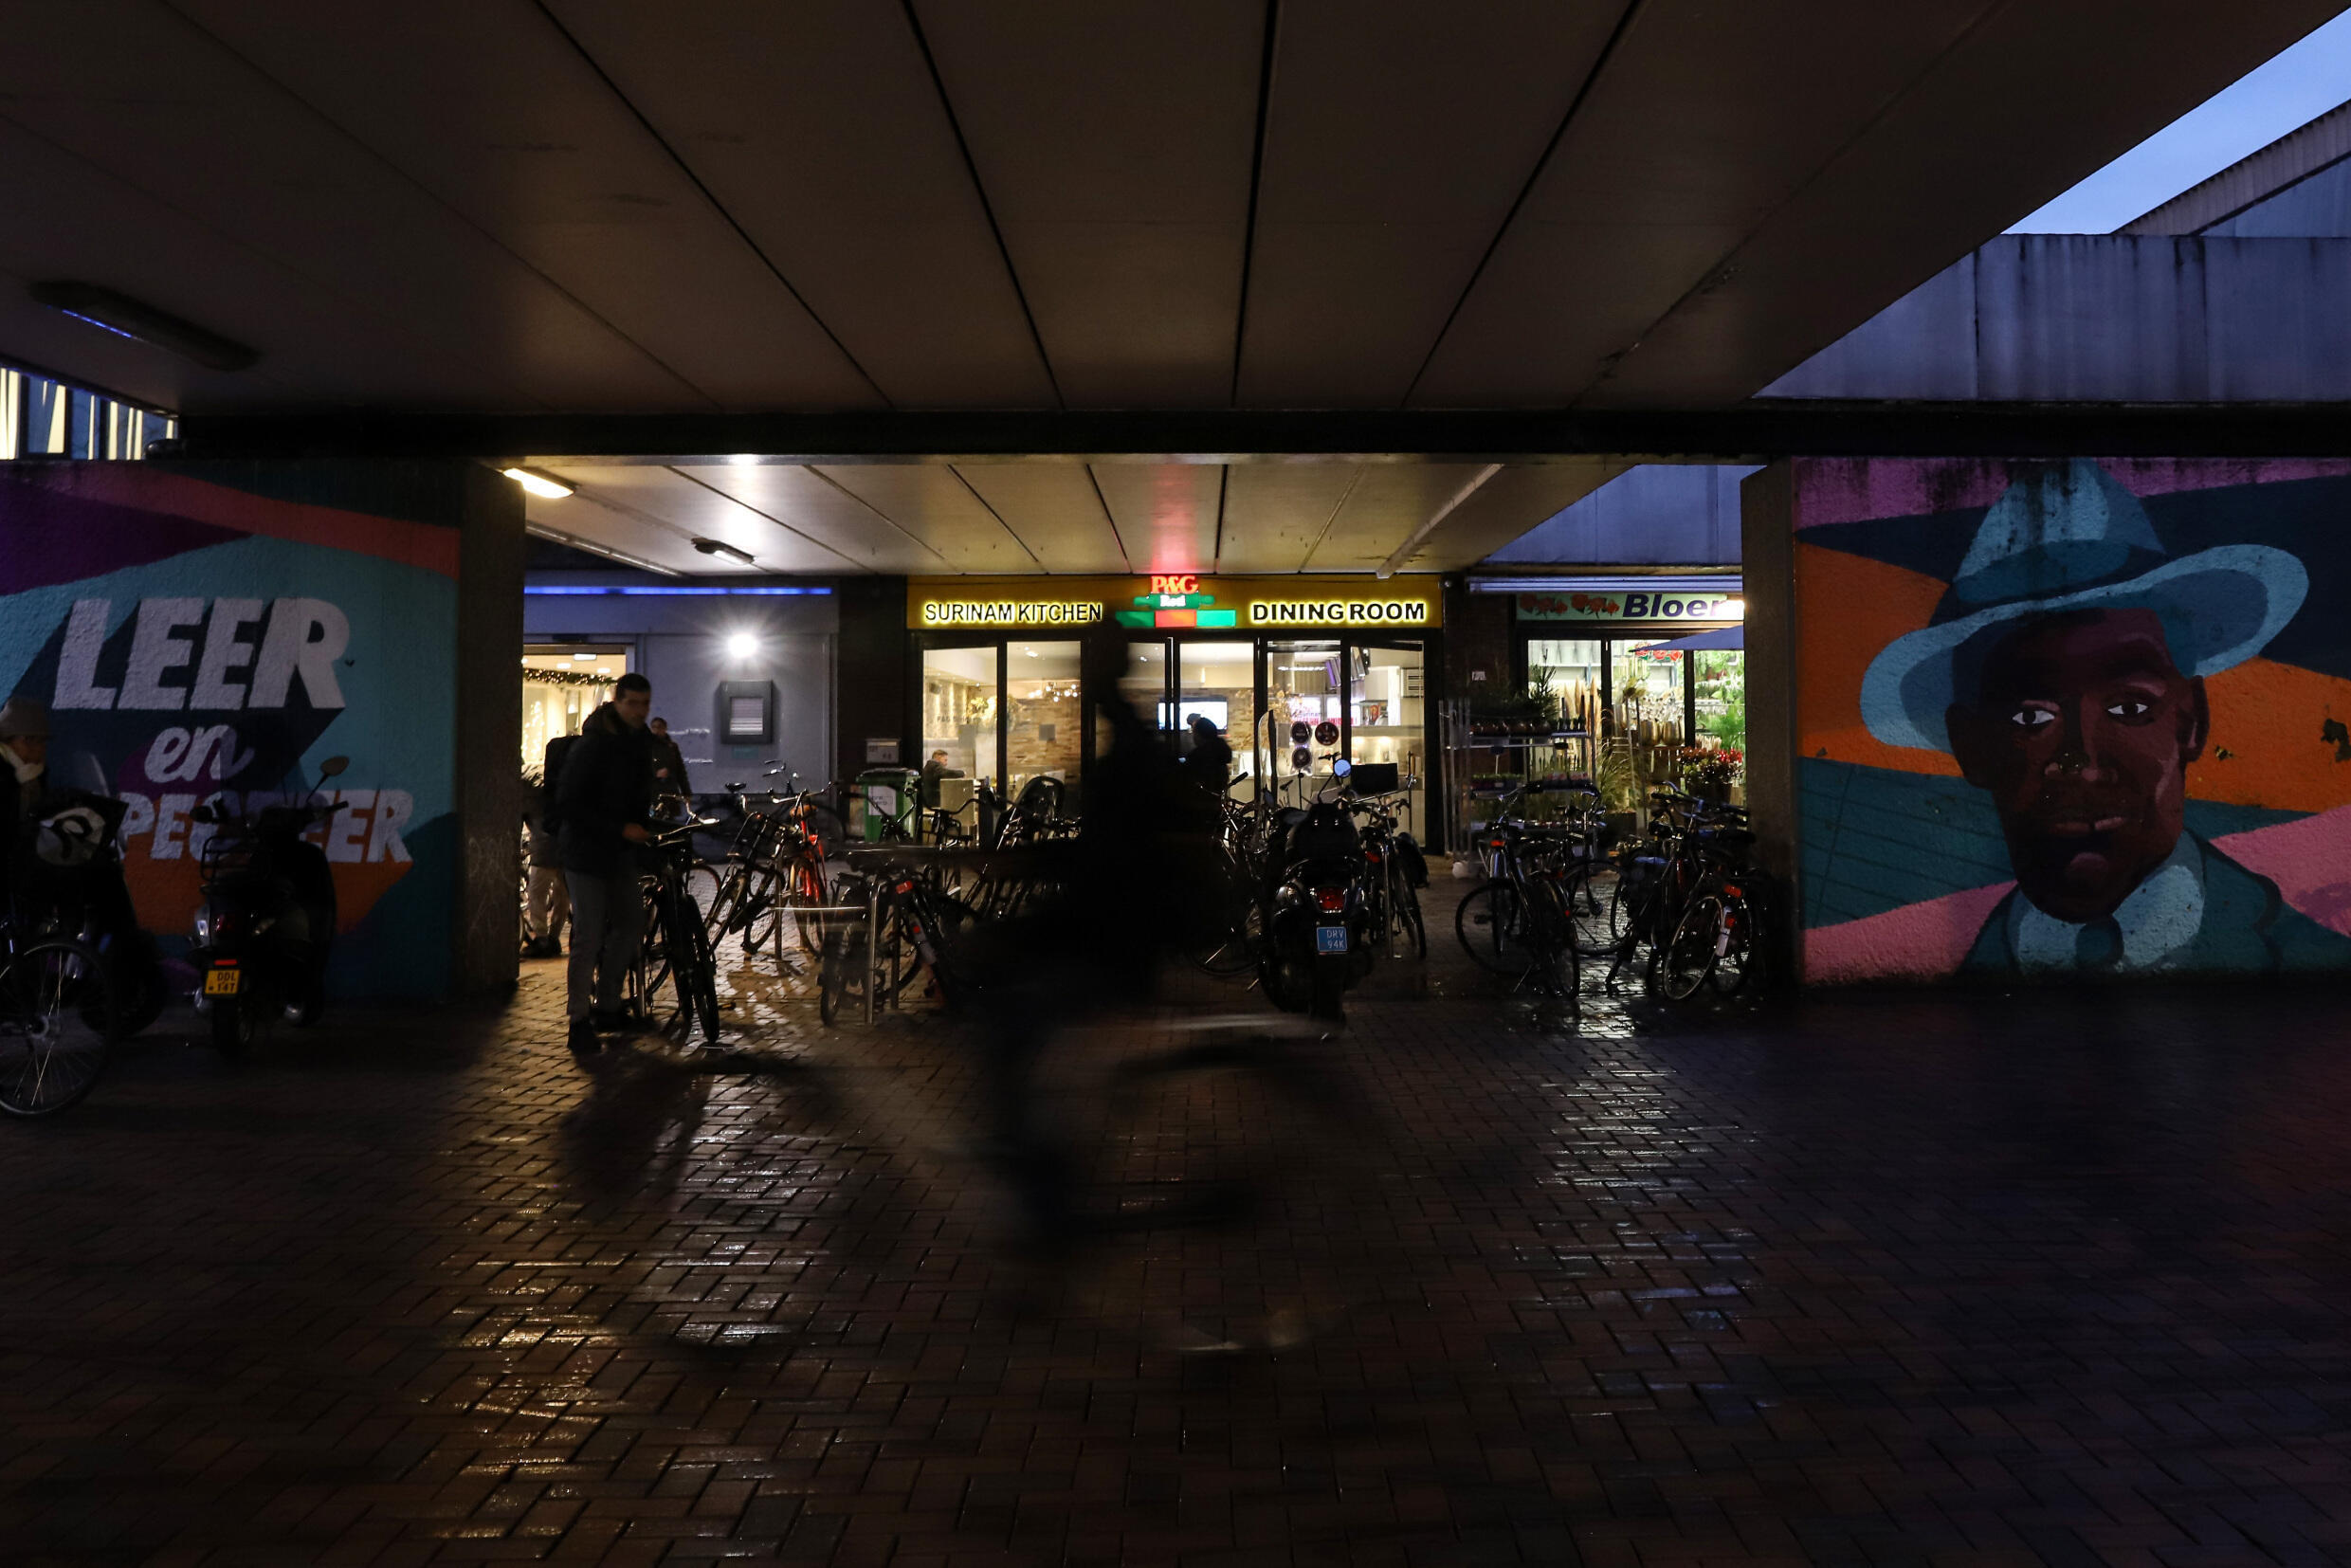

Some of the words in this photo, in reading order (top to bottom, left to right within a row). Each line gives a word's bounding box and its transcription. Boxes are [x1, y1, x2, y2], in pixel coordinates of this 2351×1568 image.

[1151, 575, 1199, 594] P&G
[925, 602, 1013, 623] SURINAM
[1017, 602, 1103, 623] KITCHEN
[1252, 603, 1343, 622] DINING
[1350, 603, 1426, 622] ROOM
[52, 597, 350, 711] LEER
[144, 723, 256, 784] en
